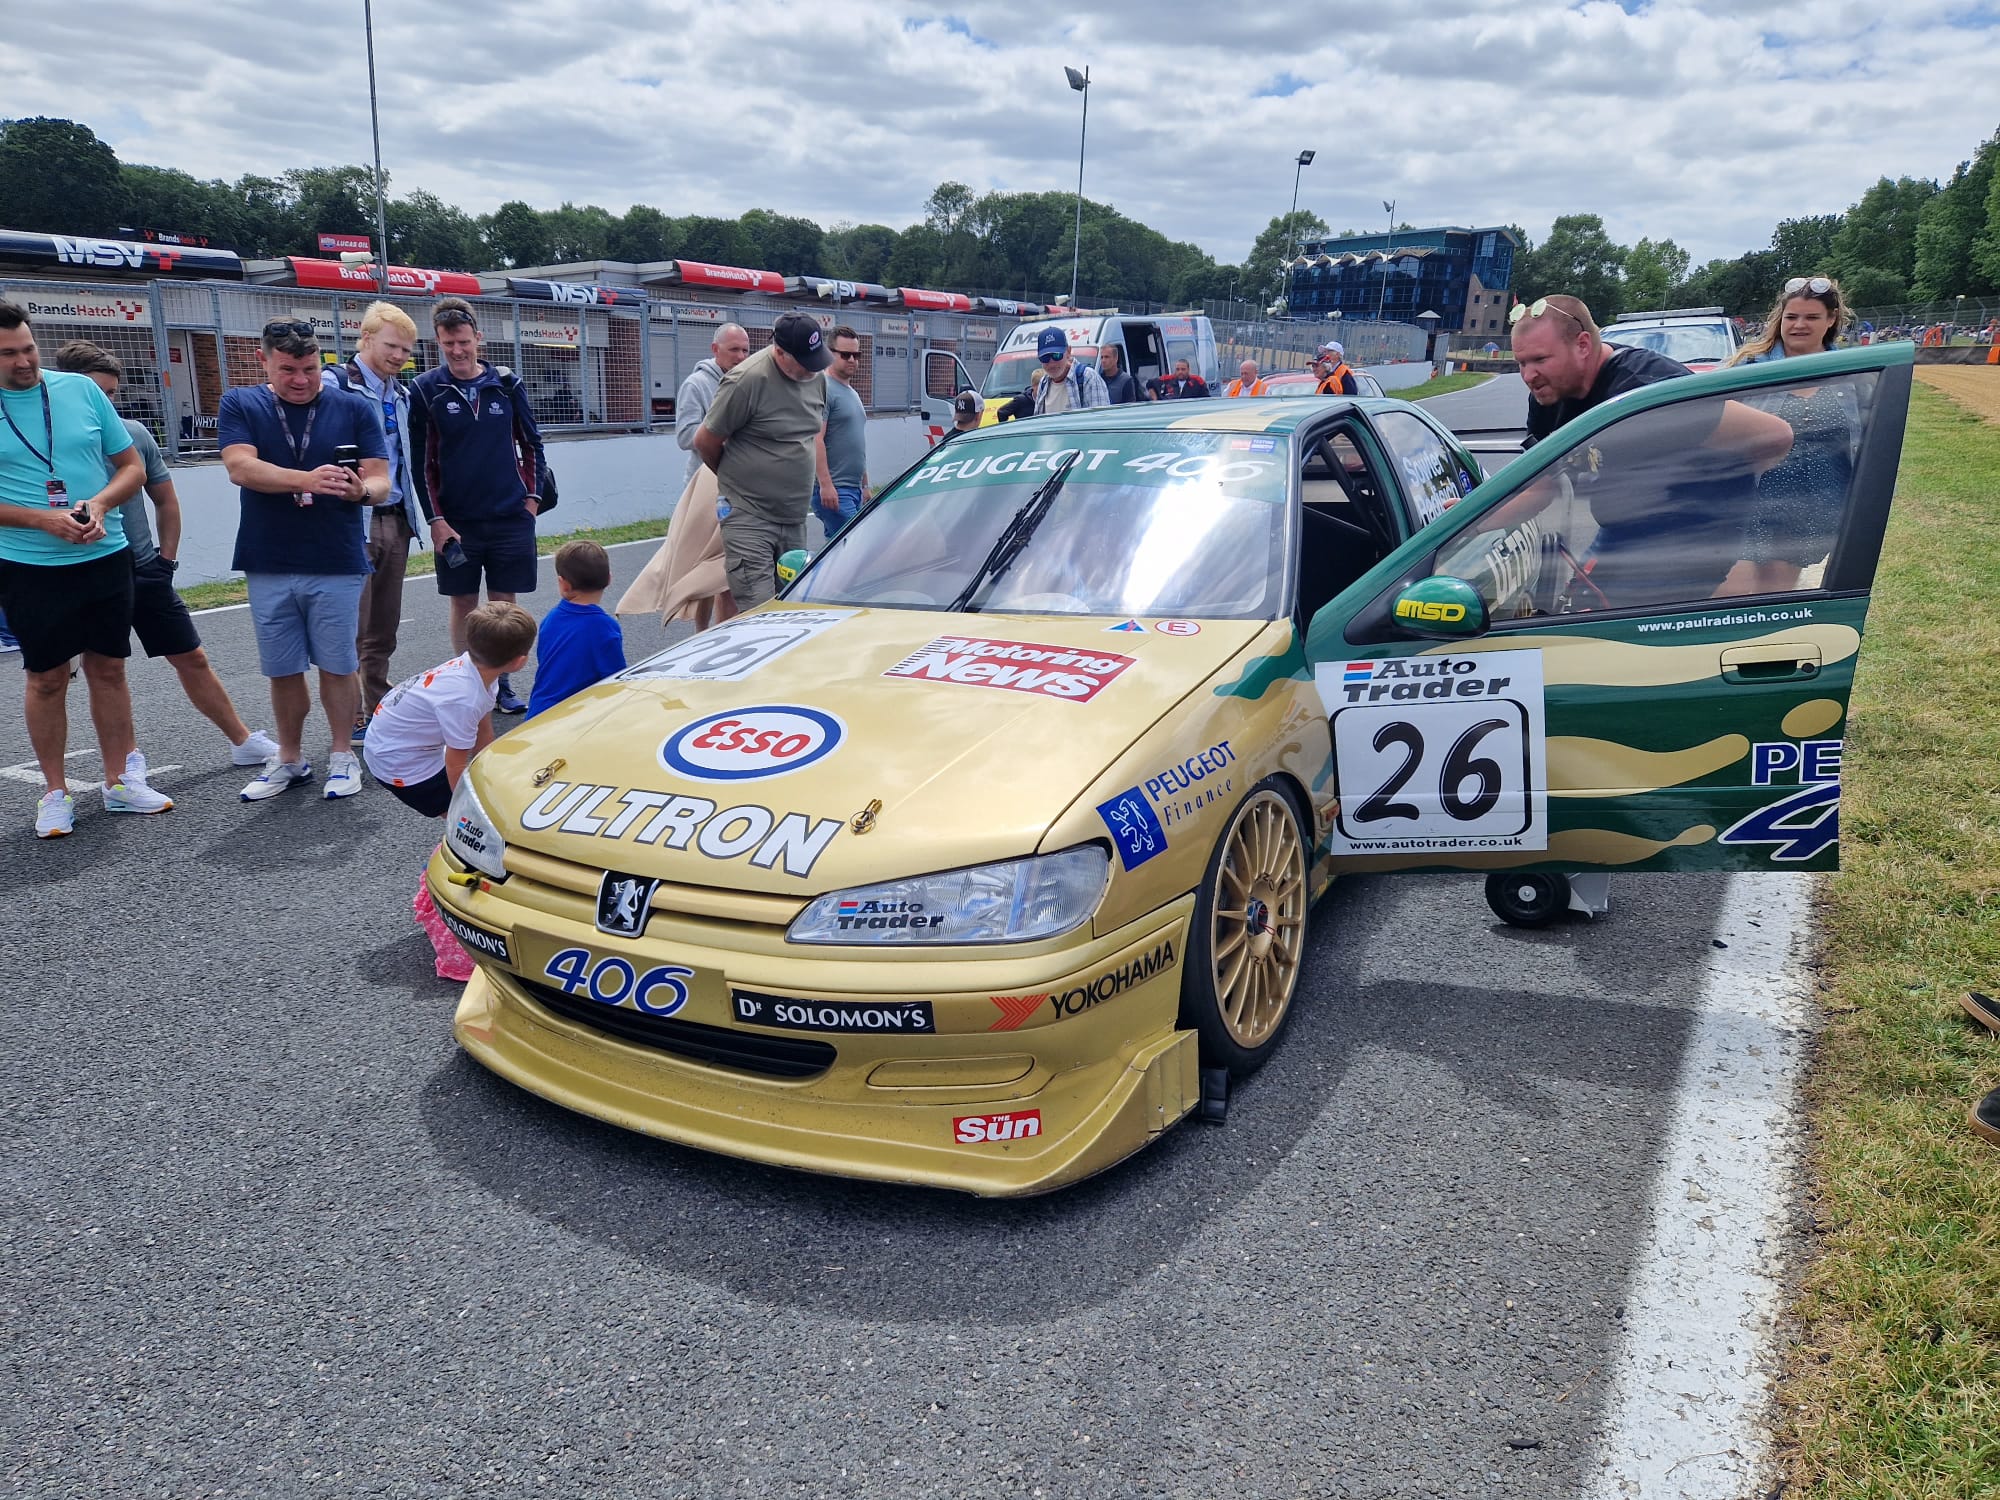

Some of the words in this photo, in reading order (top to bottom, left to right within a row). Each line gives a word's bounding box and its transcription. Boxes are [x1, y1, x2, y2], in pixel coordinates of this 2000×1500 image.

[52, 236, 143, 268] MSV
[336, 240, 357, 248] LUCAS
[704, 267, 747, 281] BrandsHatch
[548, 281, 598, 304] MSV
[27, 302, 116, 318] BrandsHatch
[906, 449, 1119, 489] PEUGEOT
[1123, 451, 1275, 483] 406
[1395, 598, 1466, 622] MSD
[1637, 607, 1813, 633] www.paulradisich.co.uk
[1167, 622, 1188, 633] E
[943, 639, 1124, 675] Motoring
[1372, 657, 1477, 680] Auto
[903, 653, 1100, 696] News
[1343, 677, 1511, 703] Trader
[1145, 740, 1237, 802] PEUGEOT
[1352, 718, 1510, 823] 26
[1163, 777, 1233, 827] Finance
[455, 828, 486, 854] Trader
[462, 820, 485, 839] Auto
[520, 781, 845, 879] ULTRON
[1349, 837, 1522, 850] www.autotrader.co.uk
[857, 900, 924, 914] Auto
[837, 914, 945, 930] Trader
[544, 947, 695, 1018] 406
[1049, 939, 1174, 1020] YOKOHAMA
[774, 1003, 926, 1028] SOLOMON'S
[956, 1116, 1039, 1144] Sun
[992, 1114, 1010, 1122] THE
